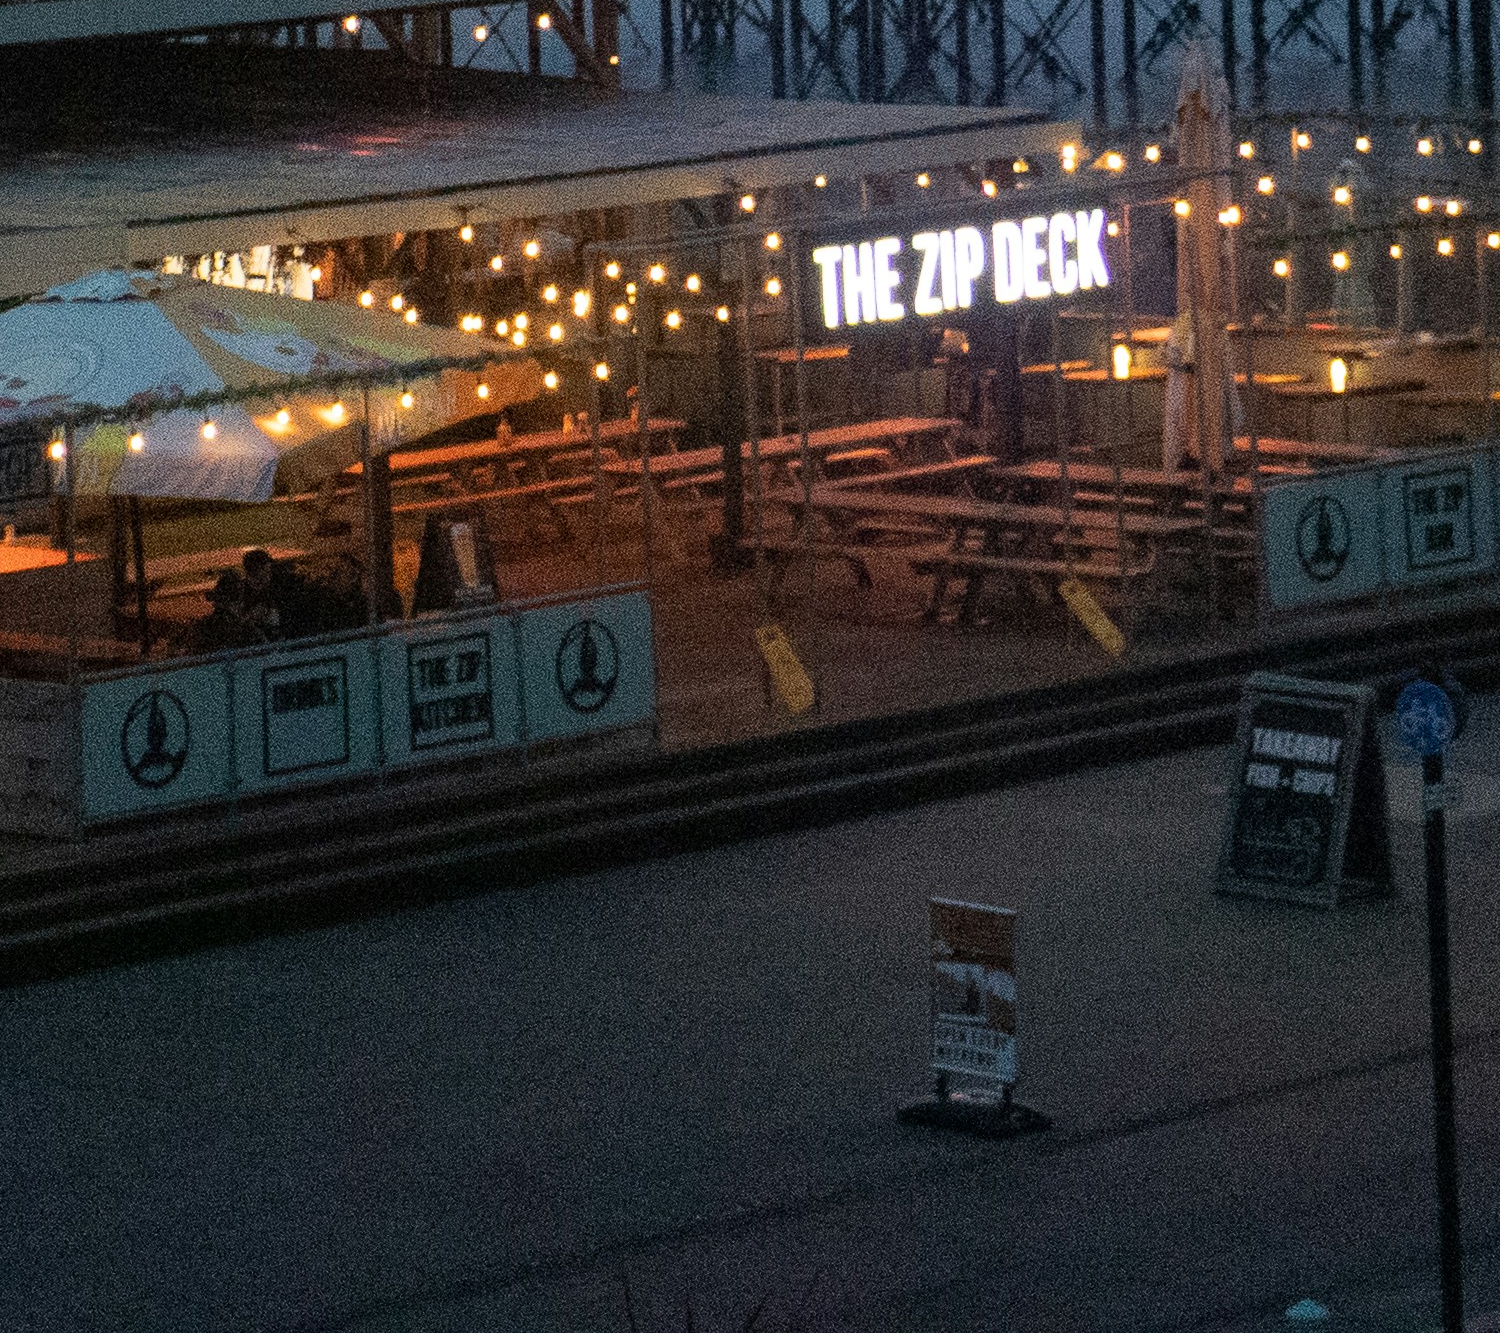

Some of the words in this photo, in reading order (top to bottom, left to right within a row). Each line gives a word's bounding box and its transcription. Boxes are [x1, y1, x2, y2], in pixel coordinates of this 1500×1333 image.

[812, 233, 906, 331] THE
[911, 225, 988, 318] ZIP
[991, 207, 1110, 306] DECK
